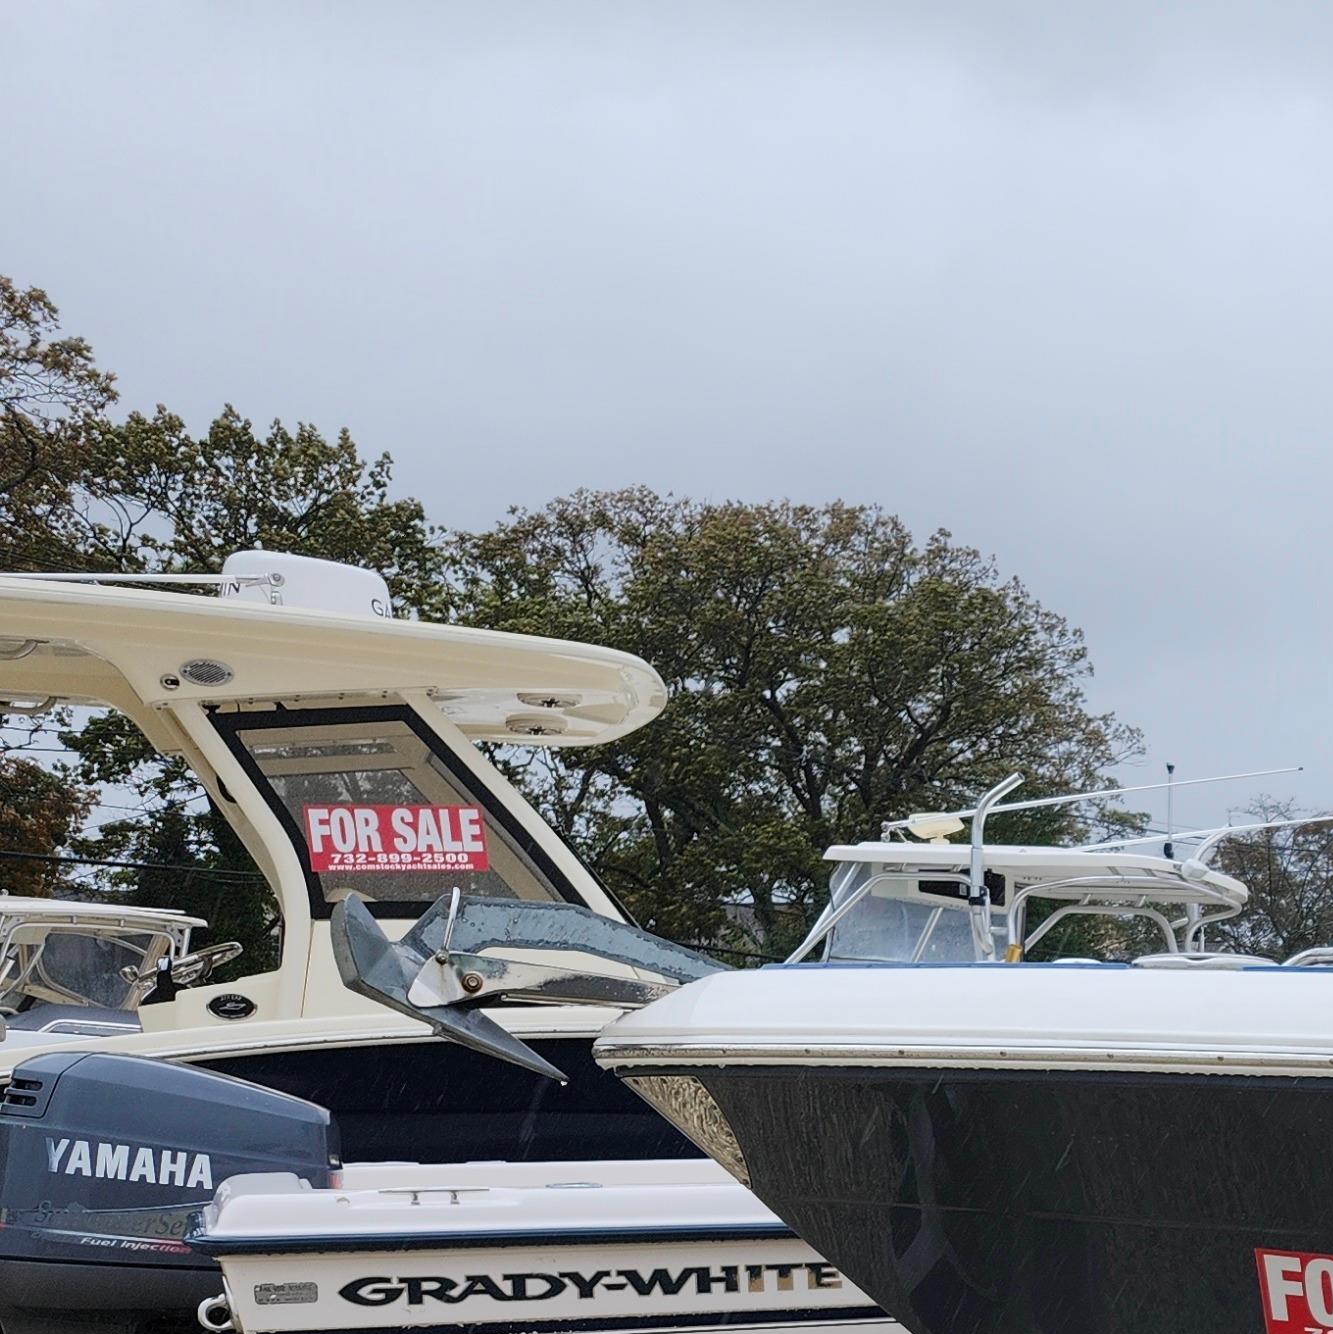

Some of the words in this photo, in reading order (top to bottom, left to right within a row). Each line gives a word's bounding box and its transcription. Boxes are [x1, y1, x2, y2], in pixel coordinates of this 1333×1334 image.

[308, 808, 384, 853] FOR
[391, 808, 484, 852] SALE
[328, 862, 474, 871] www.comstockyachtsales.com
[331, 853, 469, 864] 732-899-2500
[45, 1137, 213, 1190] YAMAHA
[80, 1236, 116, 1248] Fuel
[337, 1261, 843, 1307] GRADY-WHITE
